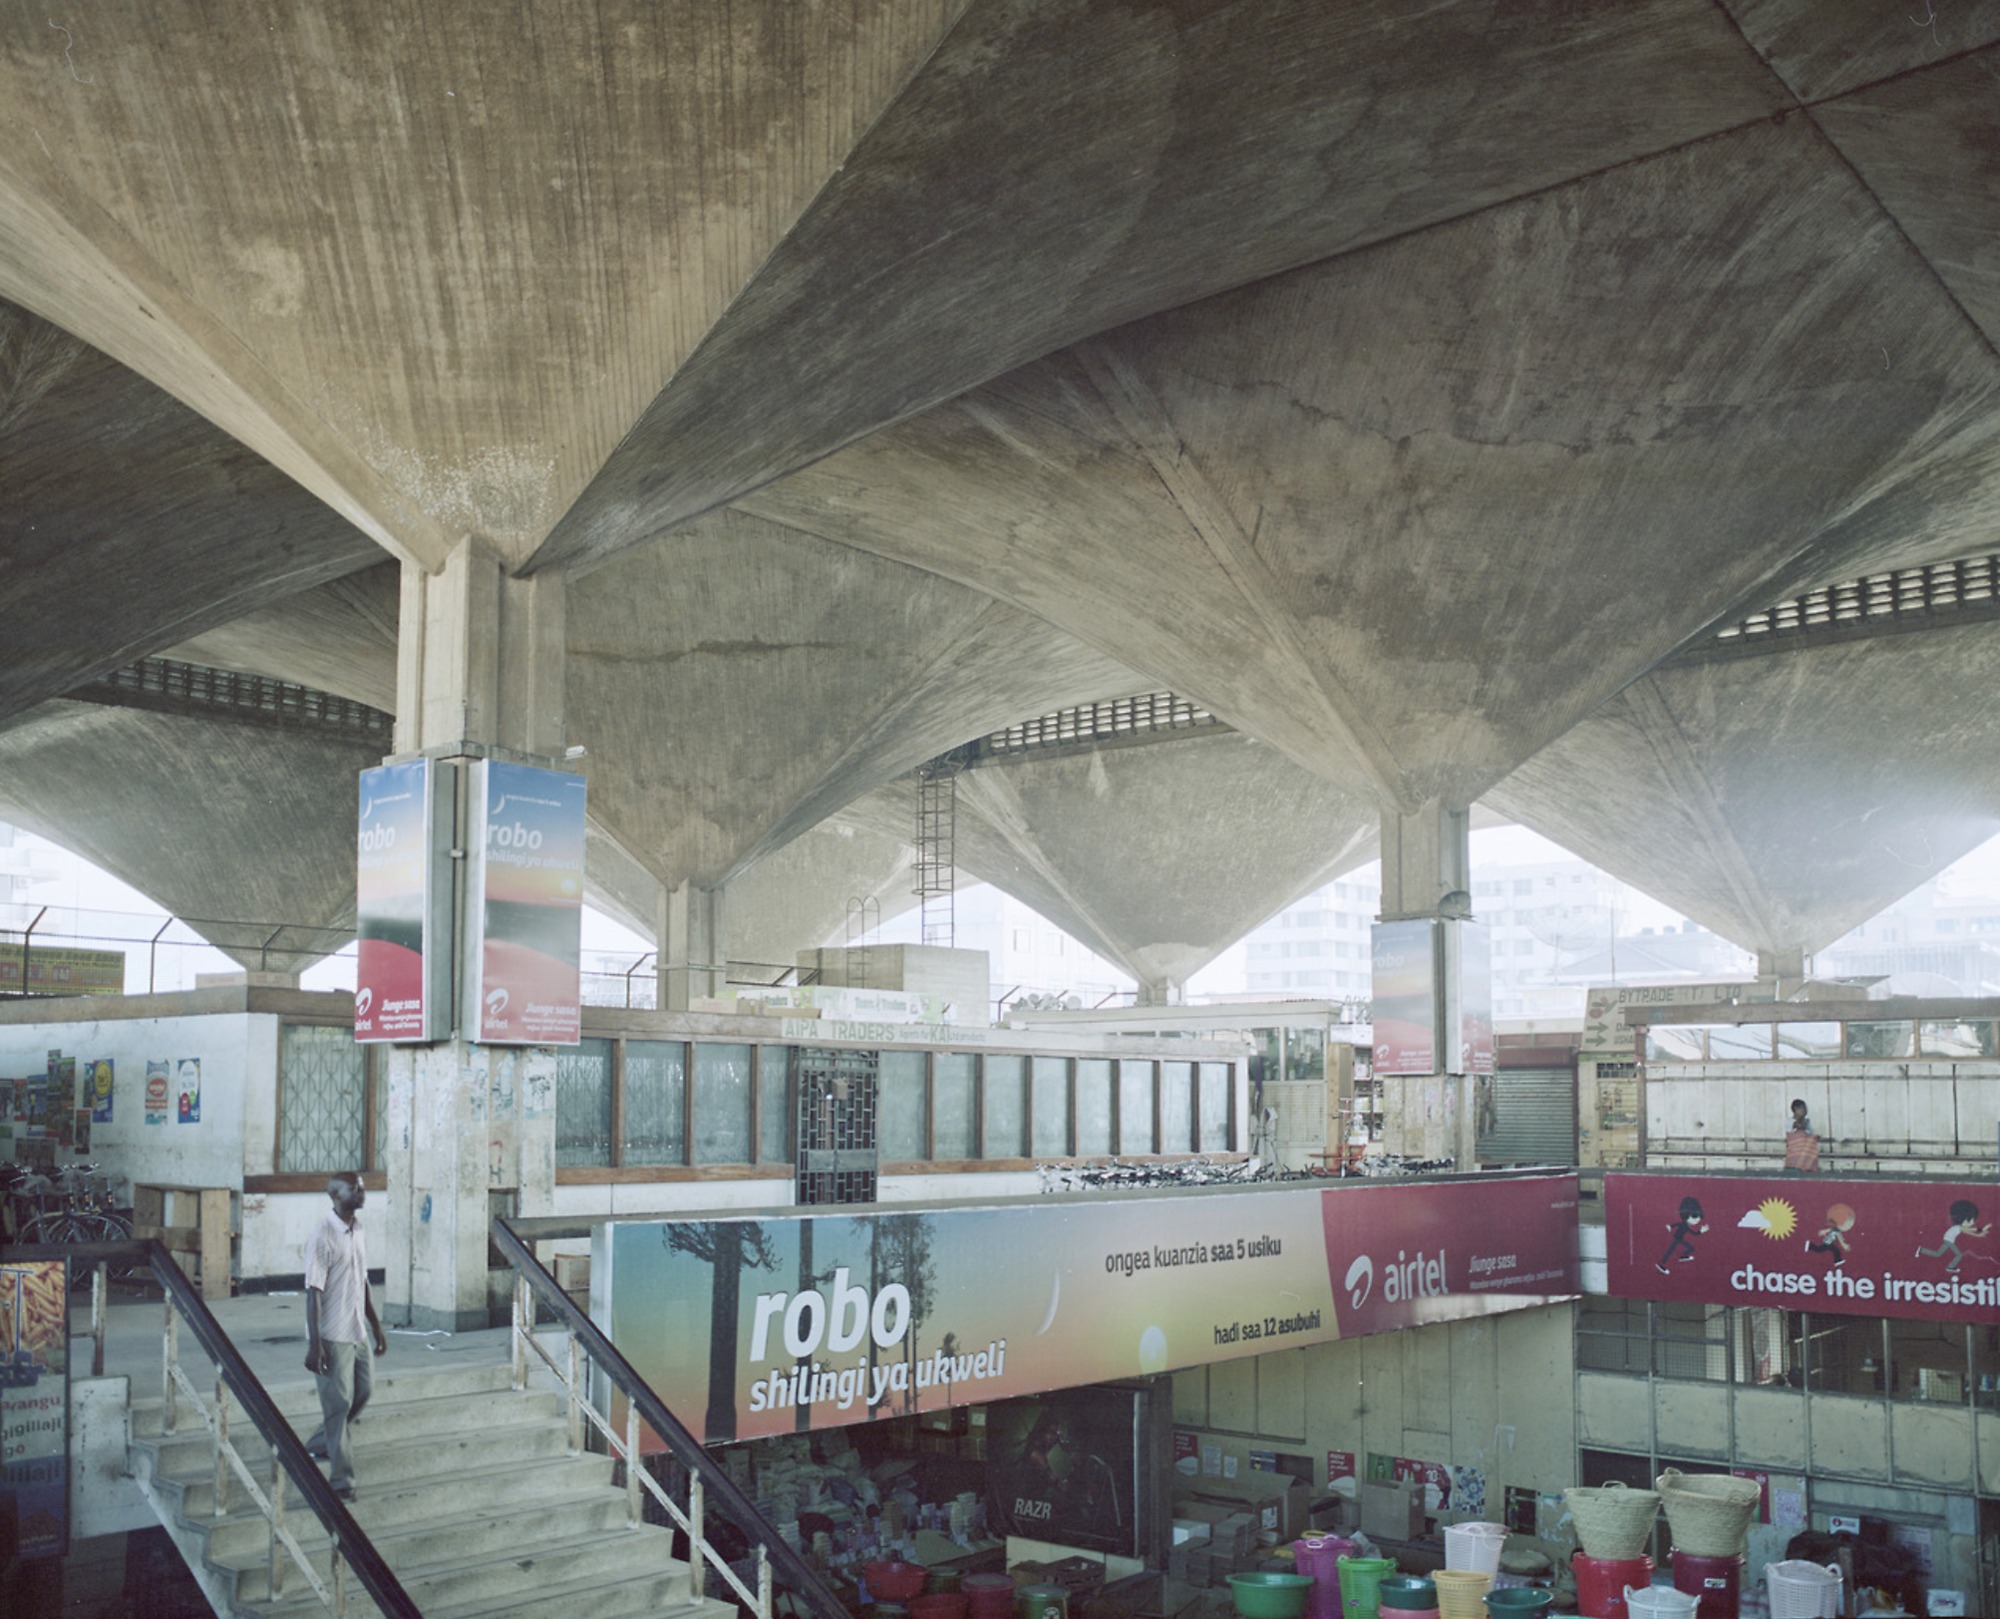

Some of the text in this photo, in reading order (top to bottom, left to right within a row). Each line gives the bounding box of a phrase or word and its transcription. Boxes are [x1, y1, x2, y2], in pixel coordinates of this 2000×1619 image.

[487, 821, 543, 850] robo
[1619, 987, 1674, 1004] BYTRADE
[830, 1020, 895, 1042] TRADERS
[1106, 1235, 1282, 1277] ongea kuanzia saa 5 usiku
[1497, 1254, 1517, 1269] sasa
[1384, 1249, 1449, 1303] airtel
[1730, 1263, 1817, 1296] chase
[1823, 1268, 1876, 1299] the
[749, 1266, 911, 1362] robo
[1214, 1308, 1321, 1345] hadi saa 12 asubuhi
[748, 1338, 1007, 1412] shilingi ya ukweli
[1013, 1497, 1053, 1521] RAZR
